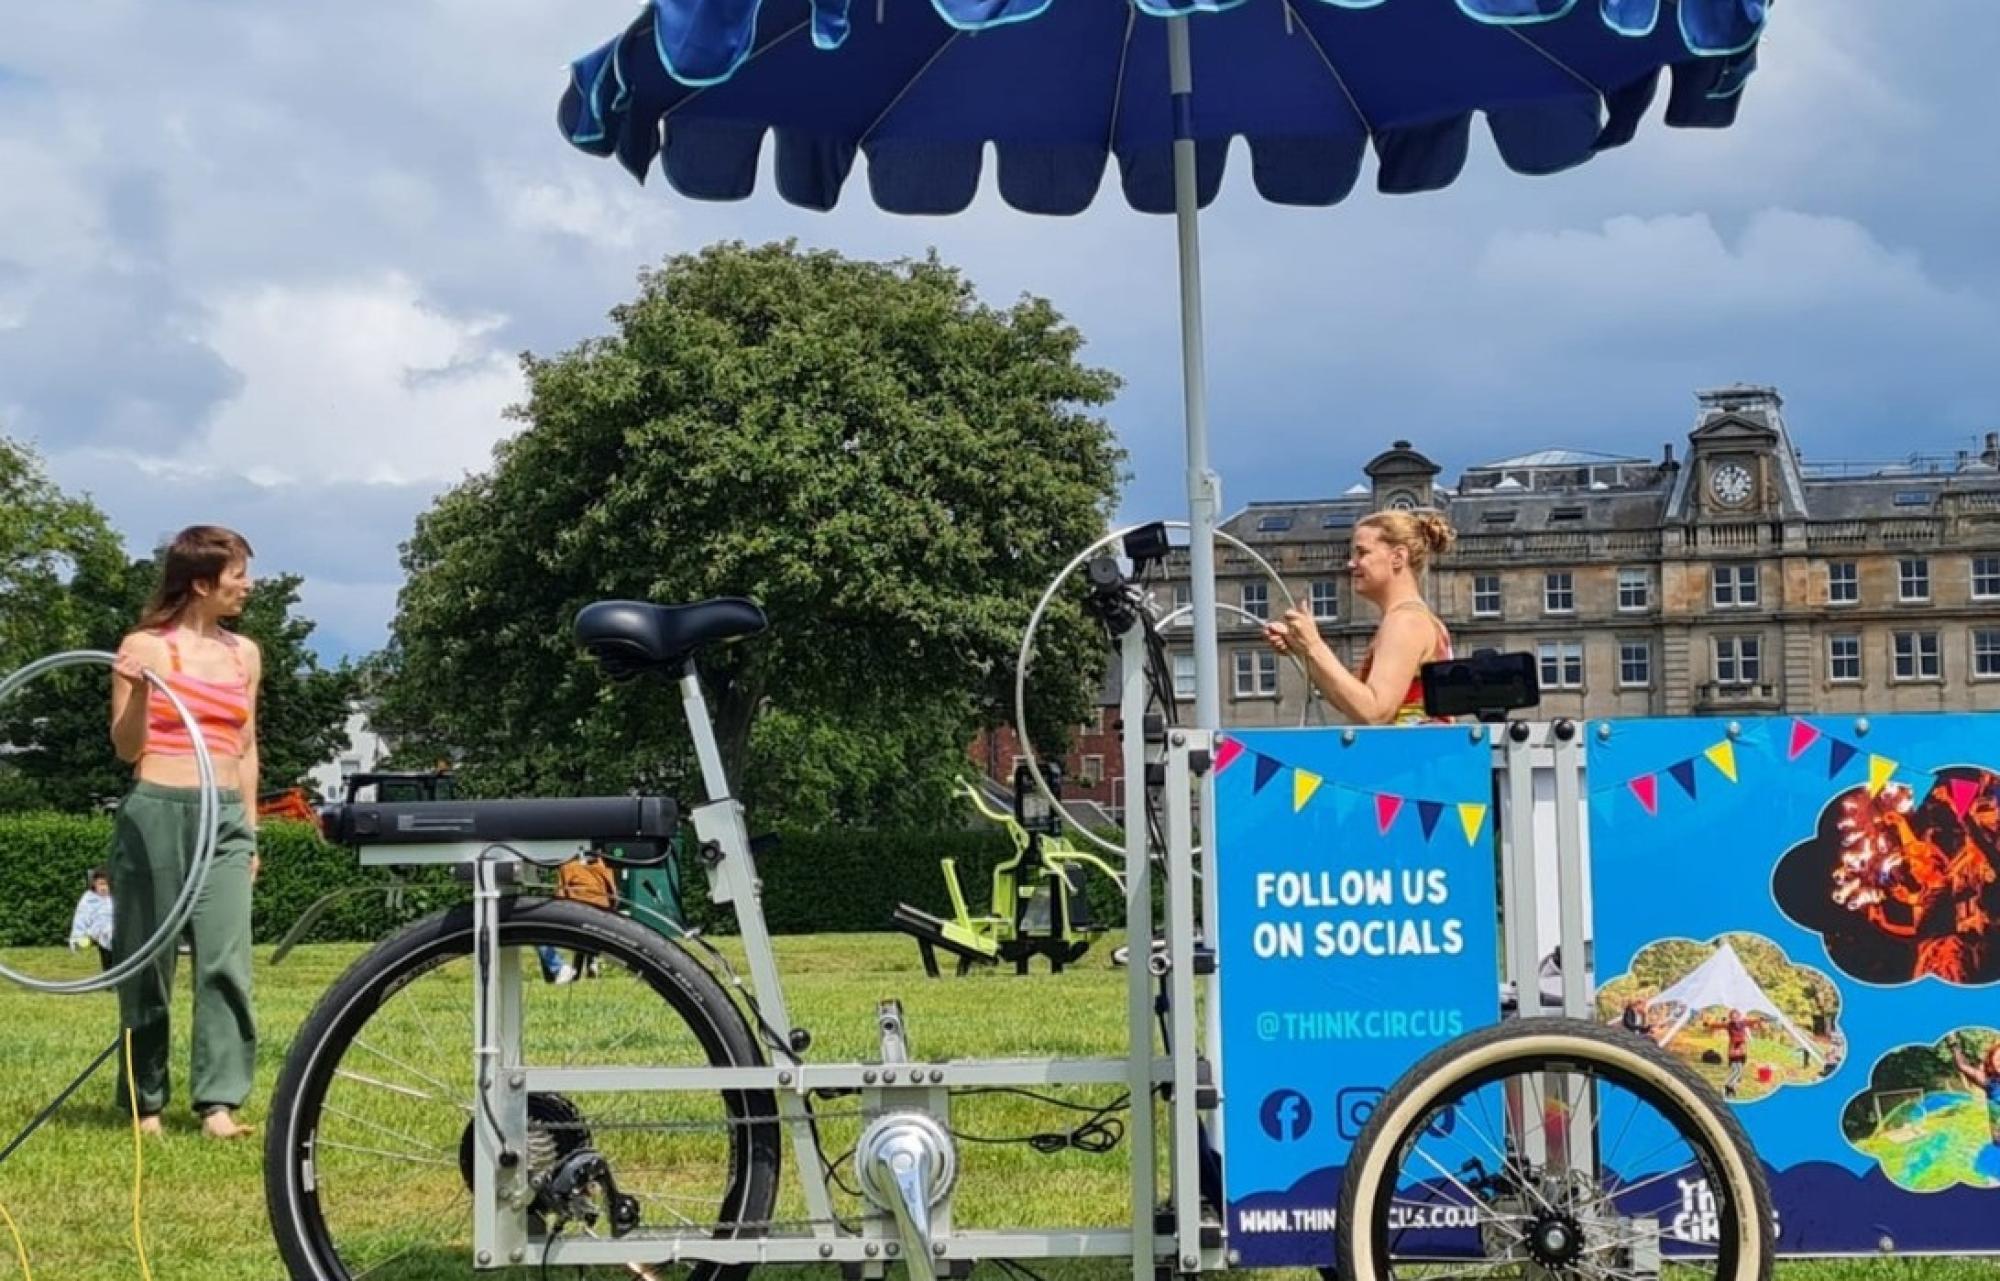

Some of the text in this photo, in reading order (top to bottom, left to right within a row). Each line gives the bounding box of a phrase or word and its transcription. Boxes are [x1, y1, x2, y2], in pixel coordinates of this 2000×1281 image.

[1256, 869, 1448, 908] FOLLOW US
[1253, 918, 1464, 958] ON SOCIALS
[1256, 1009, 1464, 1041] @THINKCIRCUS
